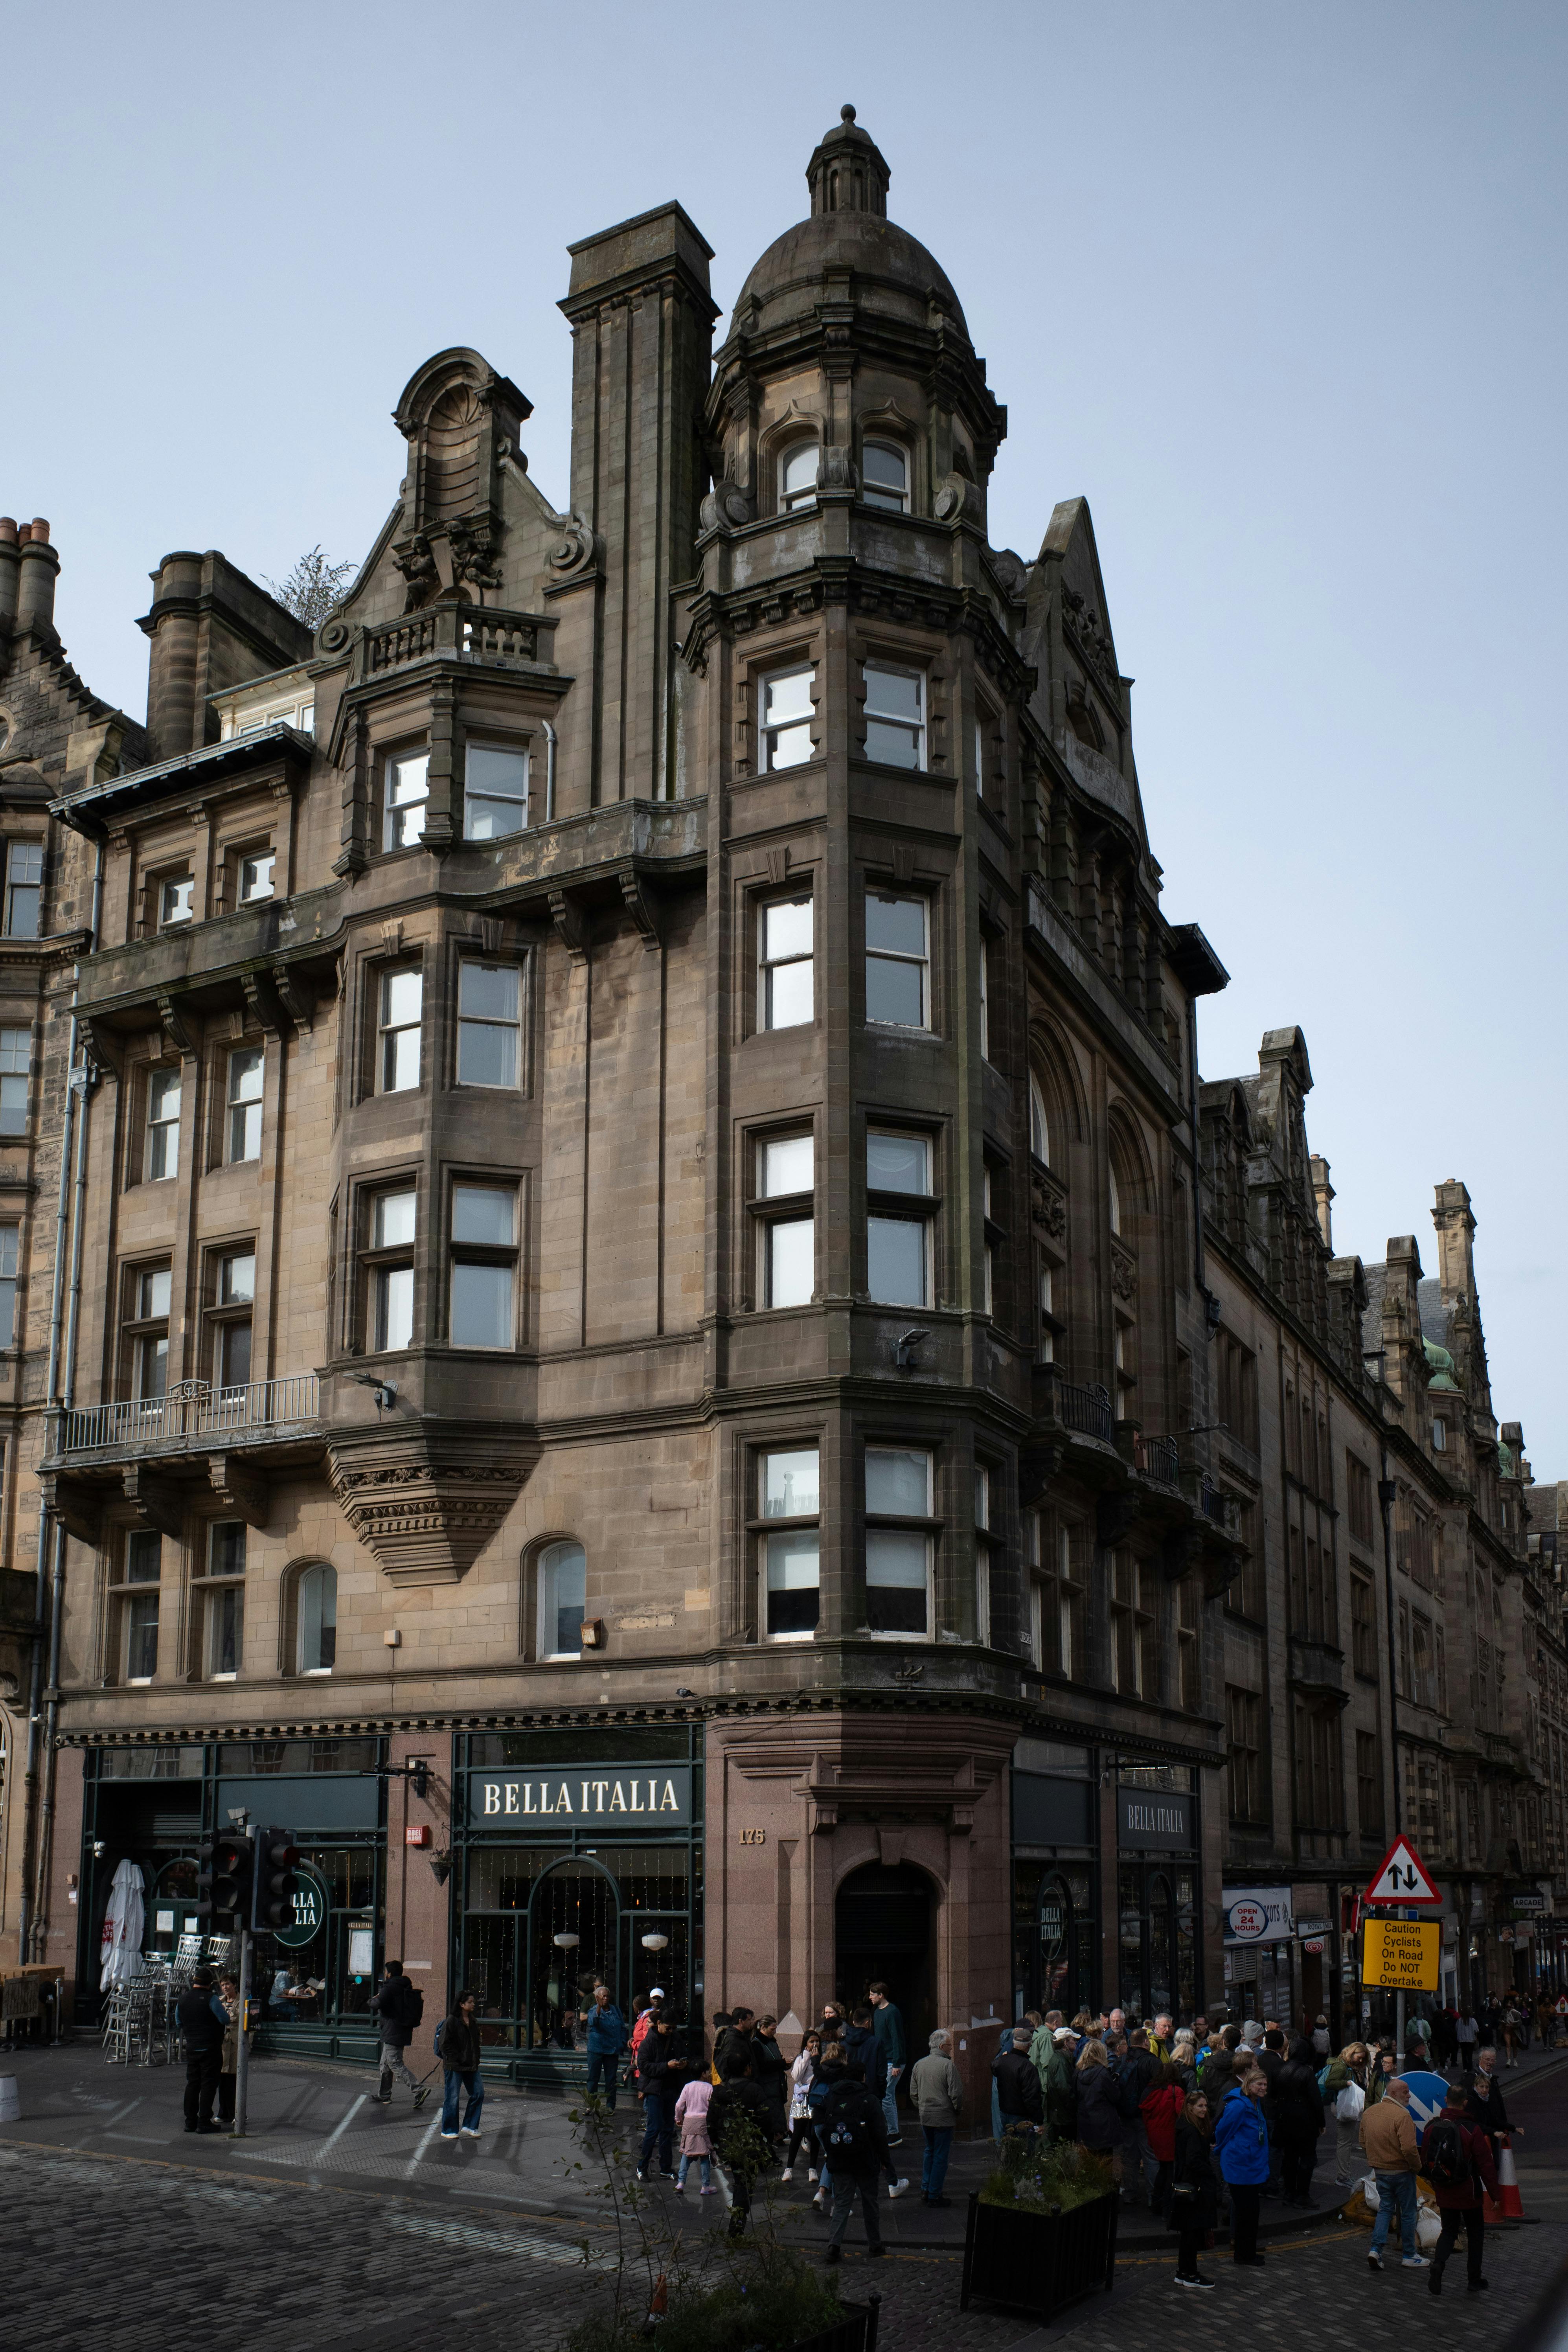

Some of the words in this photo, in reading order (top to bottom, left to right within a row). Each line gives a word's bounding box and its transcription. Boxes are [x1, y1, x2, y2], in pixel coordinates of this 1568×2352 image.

[484, 1782, 573, 1814] BELLA
[581, 1779, 679, 1813] ITALIA
[1128, 1805, 1155, 1831] BELLA
[1157, 1808, 1183, 1833] ITALIA
[739, 1828, 764, 1844] 175
[293, 1892, 315, 1907] LLA
[295, 1909, 316, 1924] LIA
[1041, 1907, 1061, 1923] BELLA
[1264, 1904, 1279, 1922] COTS
[1041, 1925, 1061, 1940] ITALIA
[1385, 1923, 1421, 1934] Caution
[1384, 1936, 1421, 1947] Cyclists
[1382, 1948, 1394, 1958] On
[1399, 1949, 1423, 1960] Road
[1384, 1962, 1396, 1971] Do
[1401, 1963, 1420, 1973] NOT
[1380, 1974, 1423, 1987] Overtake
